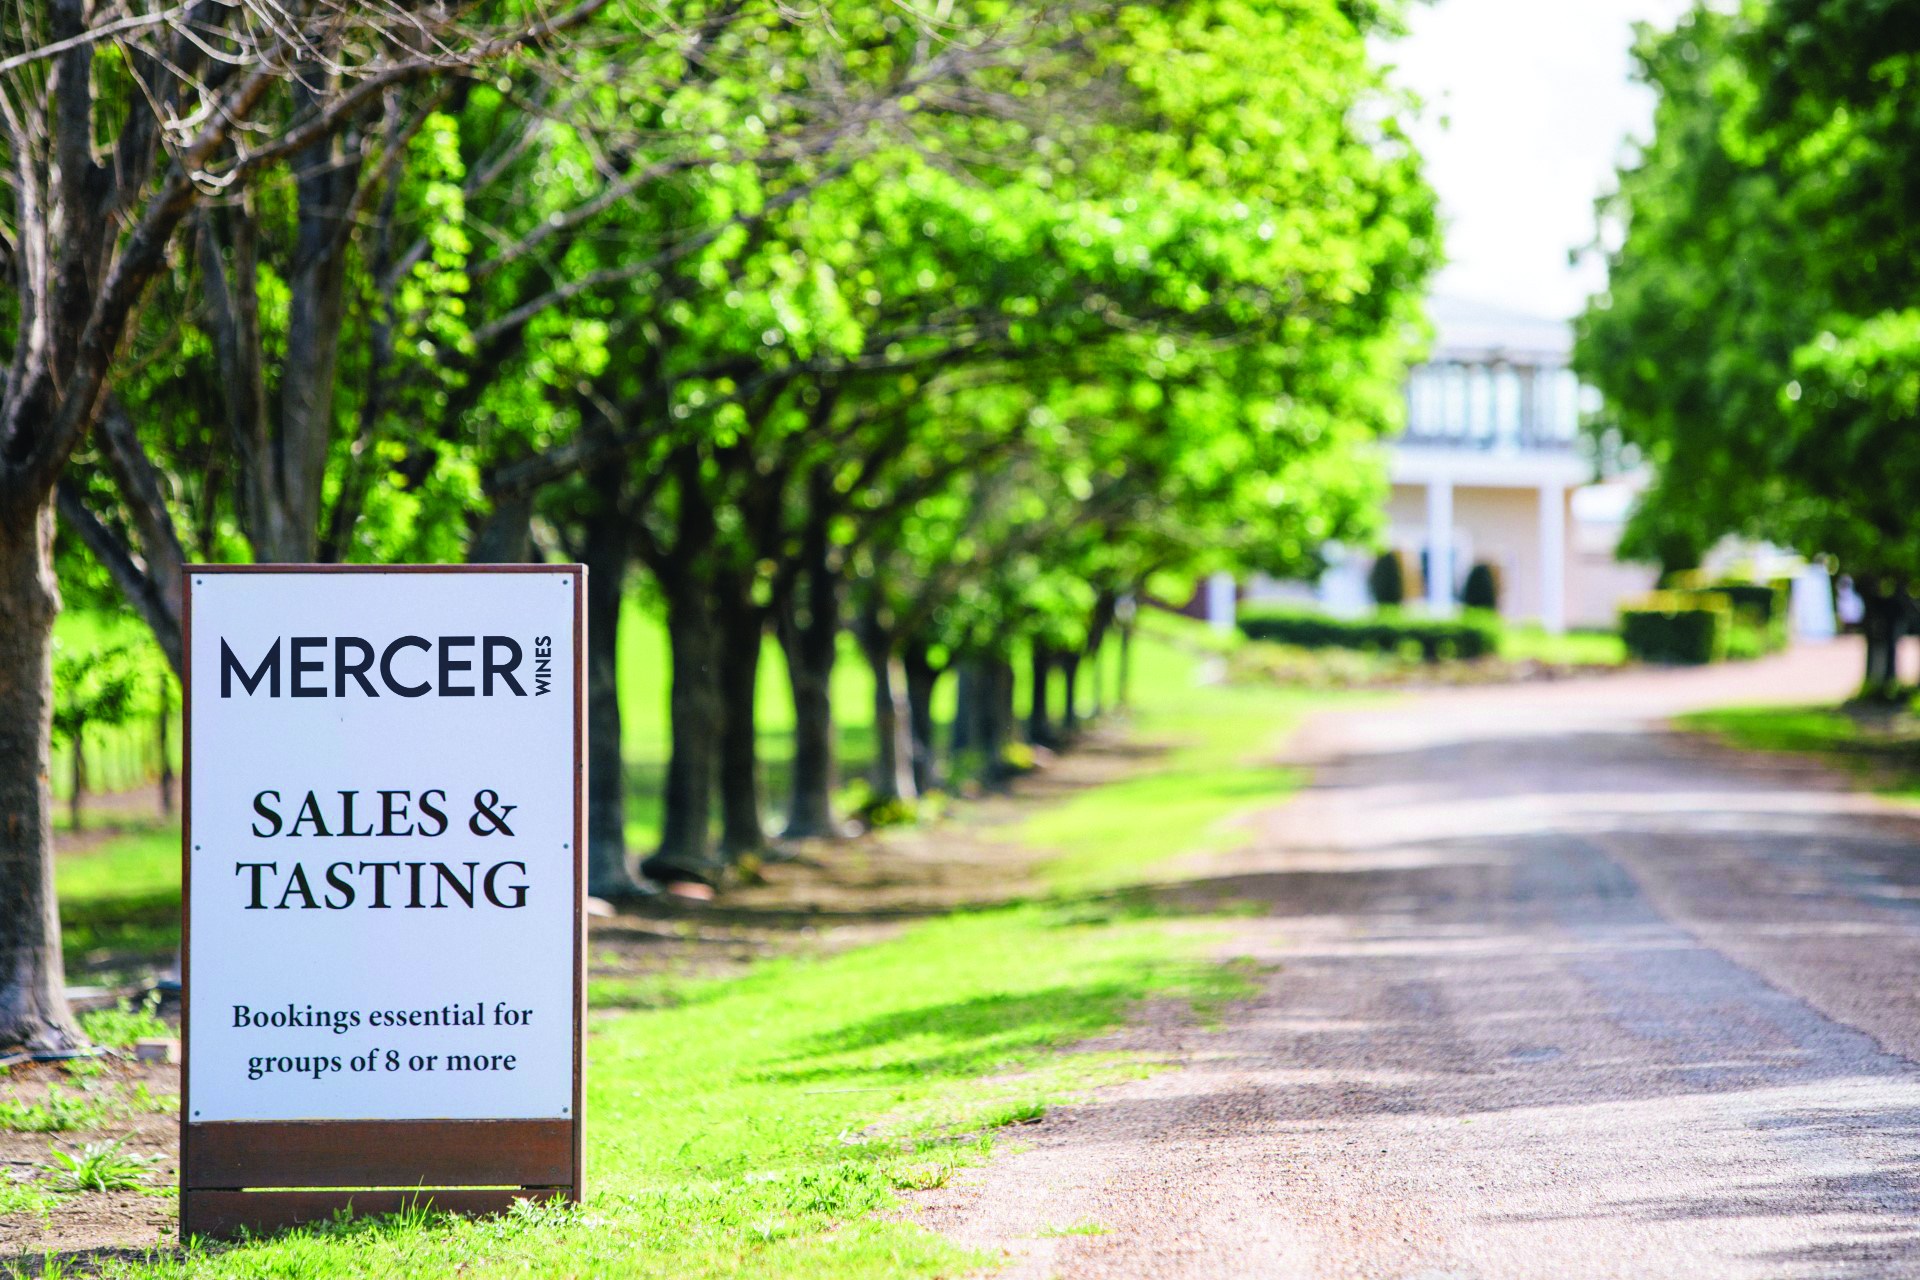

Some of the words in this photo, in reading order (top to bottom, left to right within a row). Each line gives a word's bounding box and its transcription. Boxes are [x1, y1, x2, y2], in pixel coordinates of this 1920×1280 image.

[221, 635, 528, 698] MERCER
[535, 635, 552, 697] WINES
[251, 789, 449, 838] SALES
[468, 789, 518, 837] &
[235, 860, 530, 910] TASTING
[231, 1003, 361, 1035] Bookings
[368, 1002, 485, 1027] essential
[493, 1001, 533, 1026] for
[247, 1056, 342, 1081] groups
[350, 1047, 380, 1072] of
[385, 1049, 400, 1072] 8
[408, 1055, 439, 1072] or
[446, 1054, 517, 1071] more
